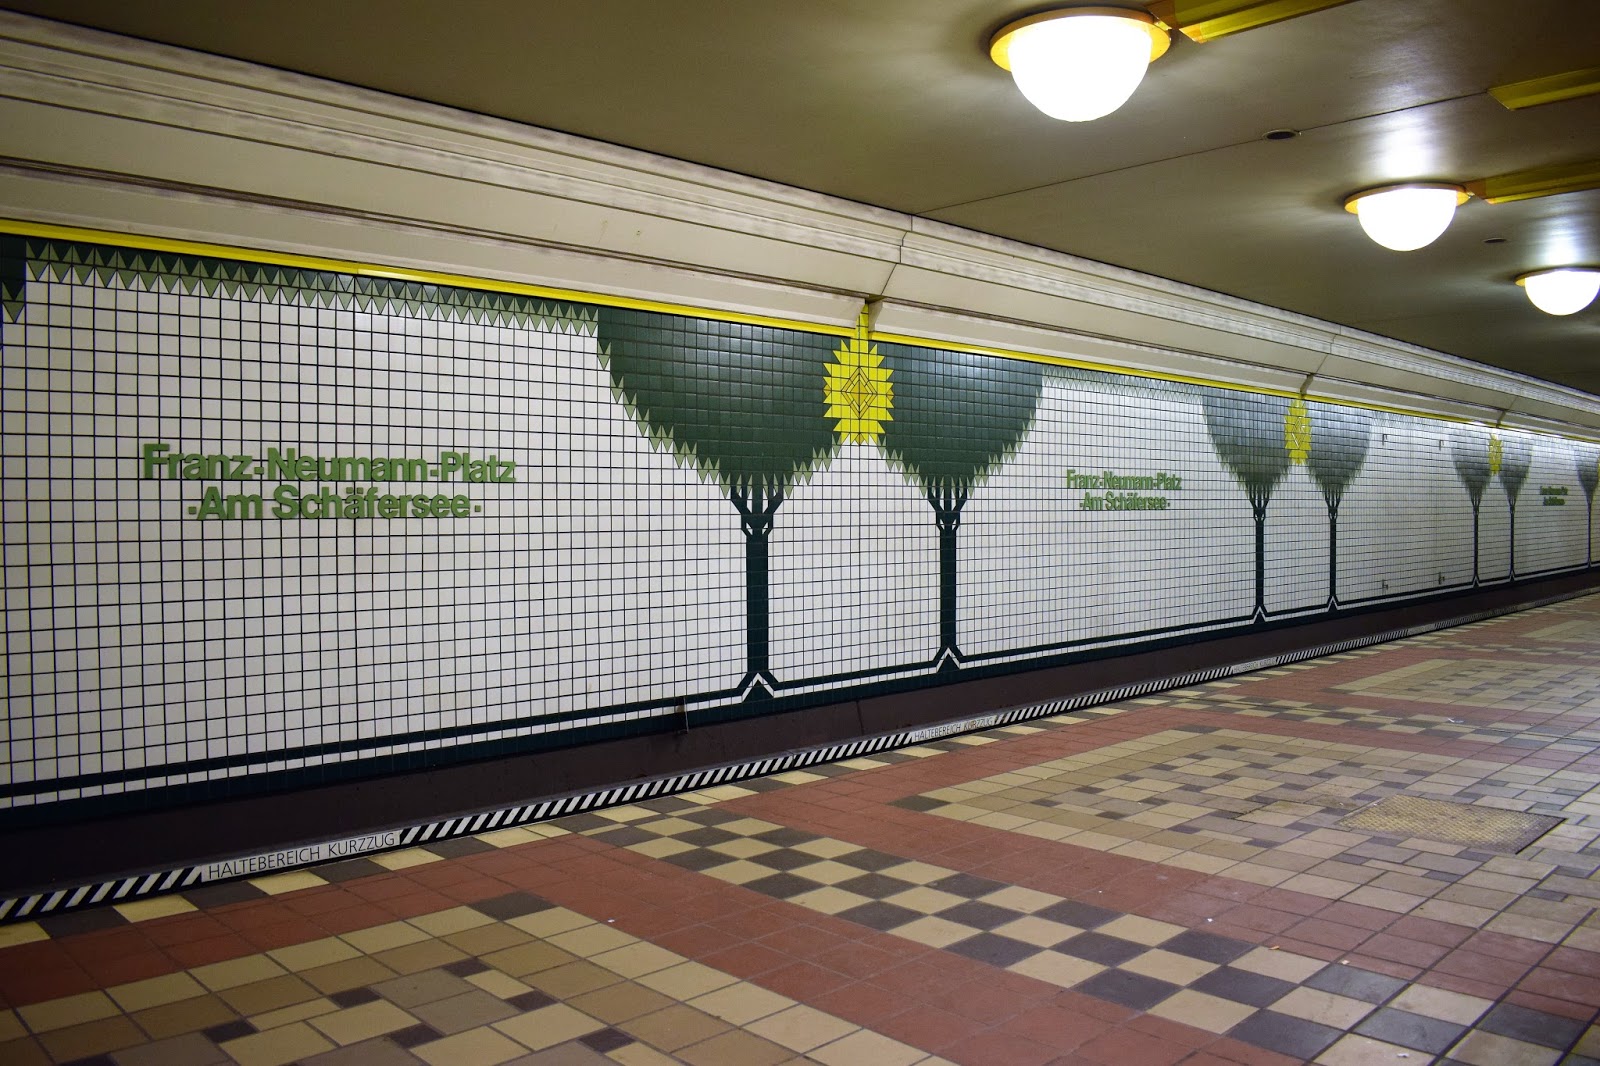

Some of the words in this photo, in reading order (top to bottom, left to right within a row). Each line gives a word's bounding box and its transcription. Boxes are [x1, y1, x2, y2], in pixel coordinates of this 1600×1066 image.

[143, 443, 517, 483] Franz-Neumann-Platz
[1067, 469, 1182, 490] Franz-Neumann-Platz
[914, 723, 961, 740] HALTEBEREICH
[209, 846, 321, 879] HALTEBEREICH
[328, 832, 396, 857] KURZZUG
